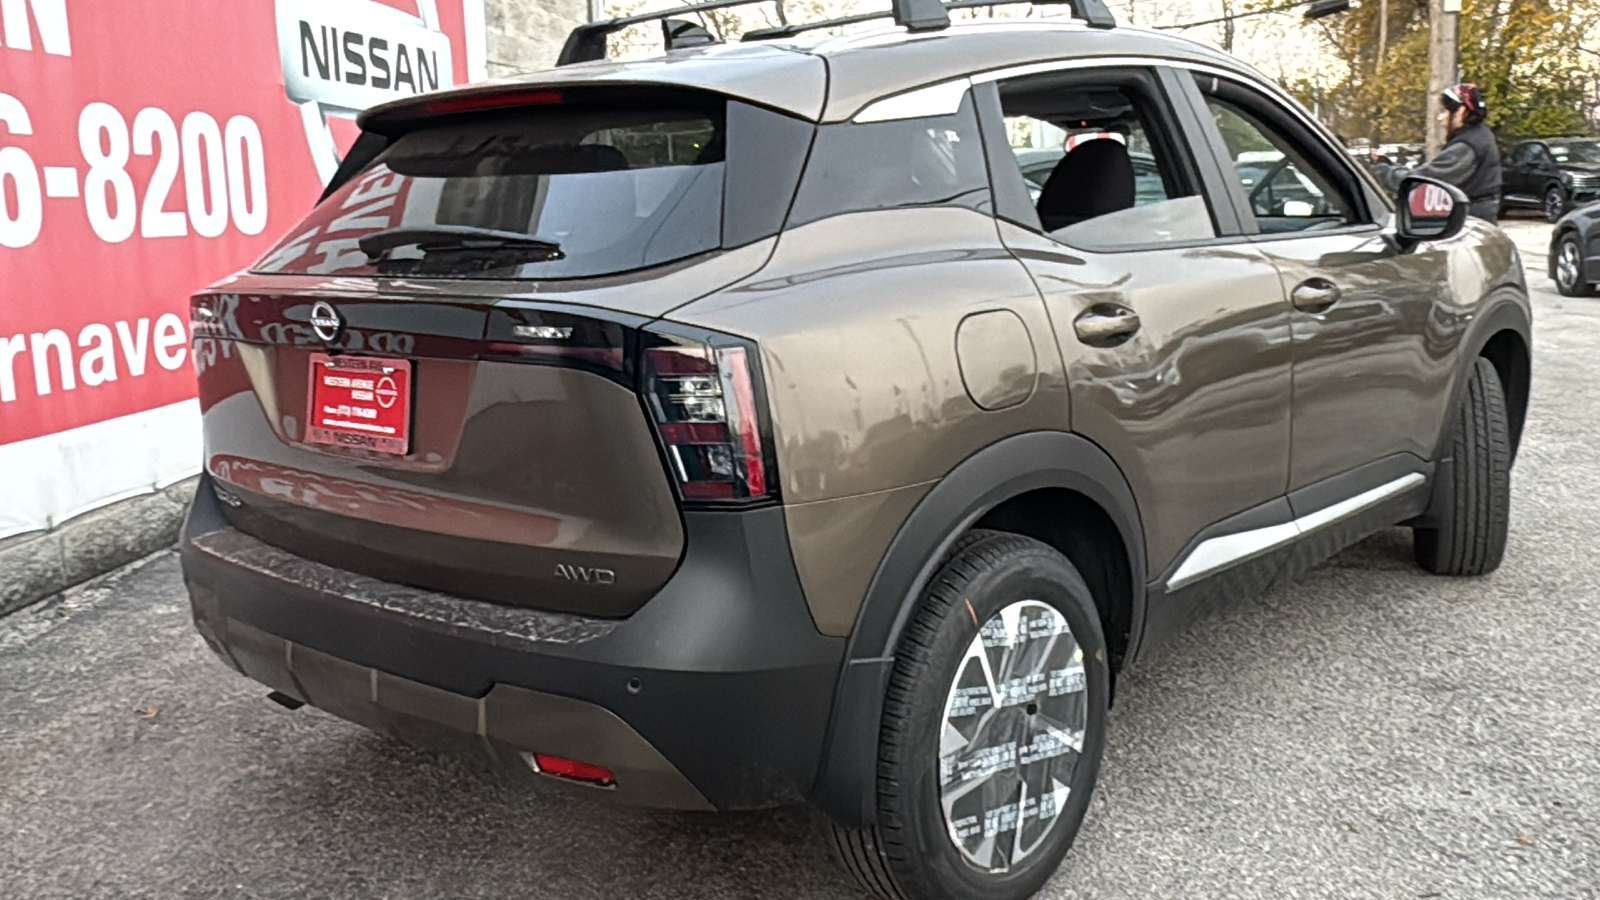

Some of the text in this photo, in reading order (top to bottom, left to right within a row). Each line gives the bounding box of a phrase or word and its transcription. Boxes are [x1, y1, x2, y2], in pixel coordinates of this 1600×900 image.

[299, 20, 438, 94] NISSAN
[0, 92, 267, 248] 6-8200
[333, 432, 377, 448] NISSAN
[553, 563, 616, 586] AWD
